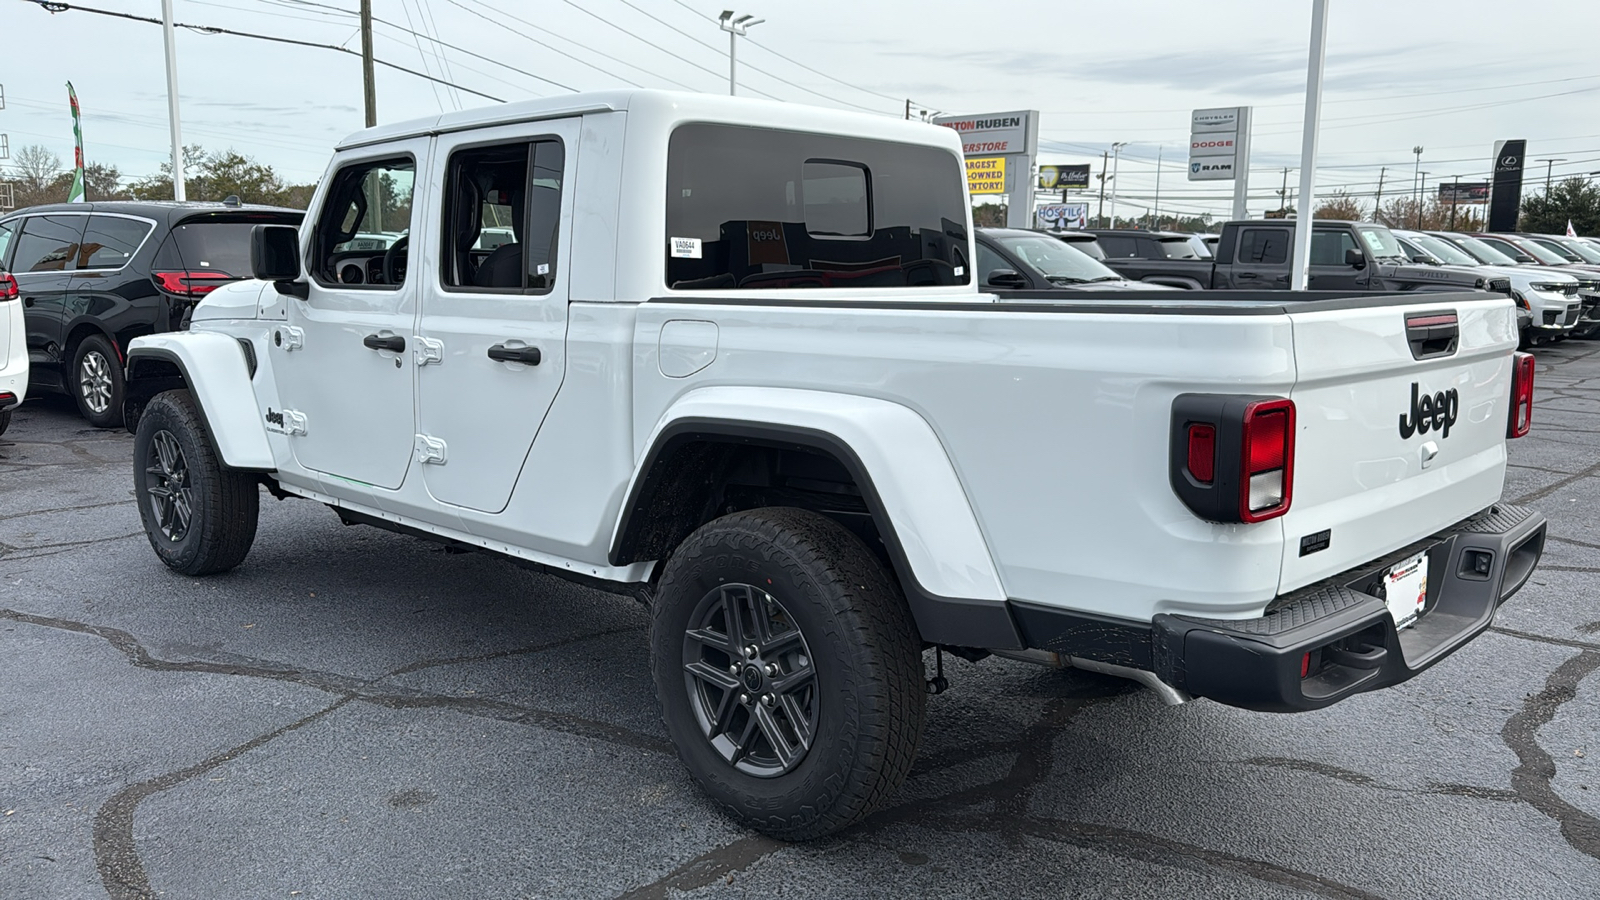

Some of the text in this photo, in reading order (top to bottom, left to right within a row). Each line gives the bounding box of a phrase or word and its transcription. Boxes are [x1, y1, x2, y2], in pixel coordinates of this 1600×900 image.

[976, 117, 1020, 129] RUBEN
[963, 141, 1008, 153] ERSTORE
[1192, 140, 1233, 149] DODGE
[1399, 381, 1459, 440] Jeep
[265, 406, 284, 428] Jeep
